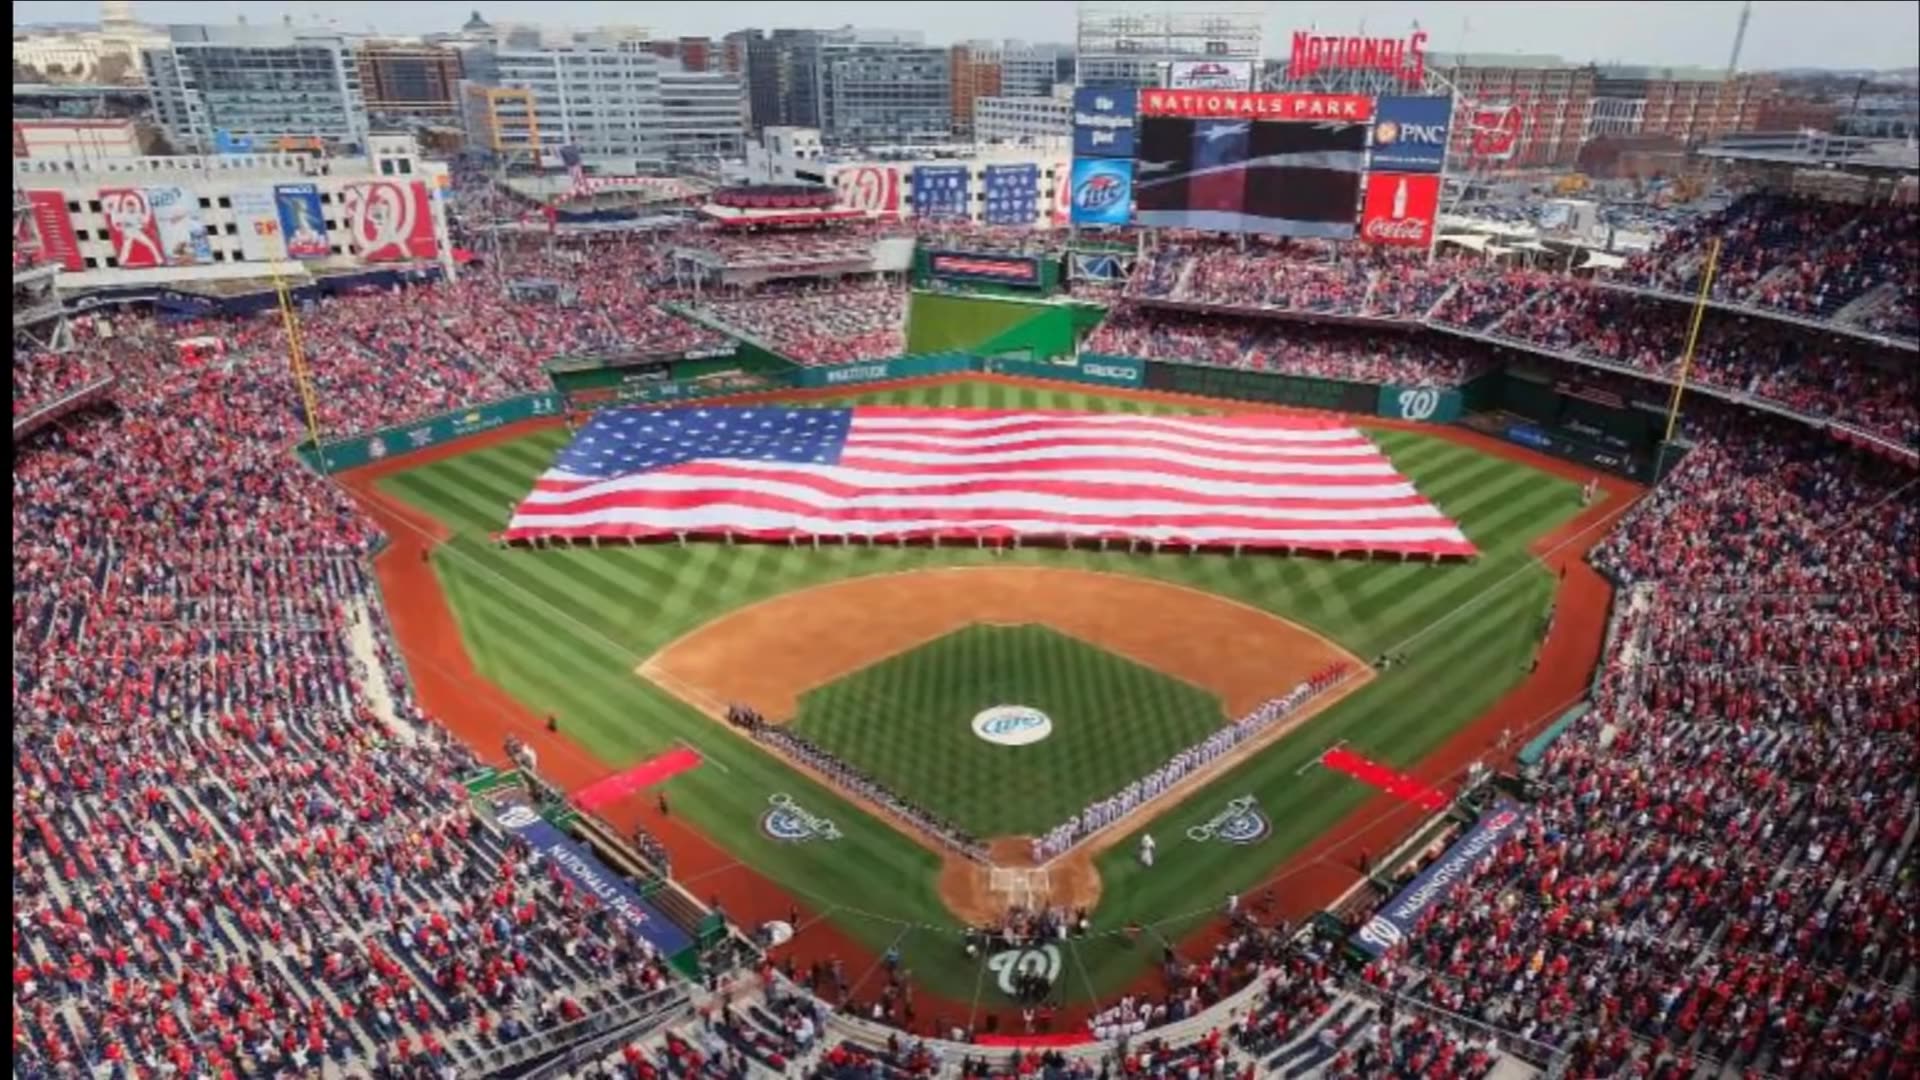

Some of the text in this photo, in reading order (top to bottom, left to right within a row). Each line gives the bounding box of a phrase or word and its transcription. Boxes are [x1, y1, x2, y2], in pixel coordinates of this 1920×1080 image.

[1288, 31, 1428, 82] NATIONALS
[1150, 94, 1357, 115] NATIONALS PARK
[1400, 122, 1446, 144] PNC
[546, 844, 651, 927] NATIONALS PARK
[1392, 857, 1467, 919] WASHINGTON
